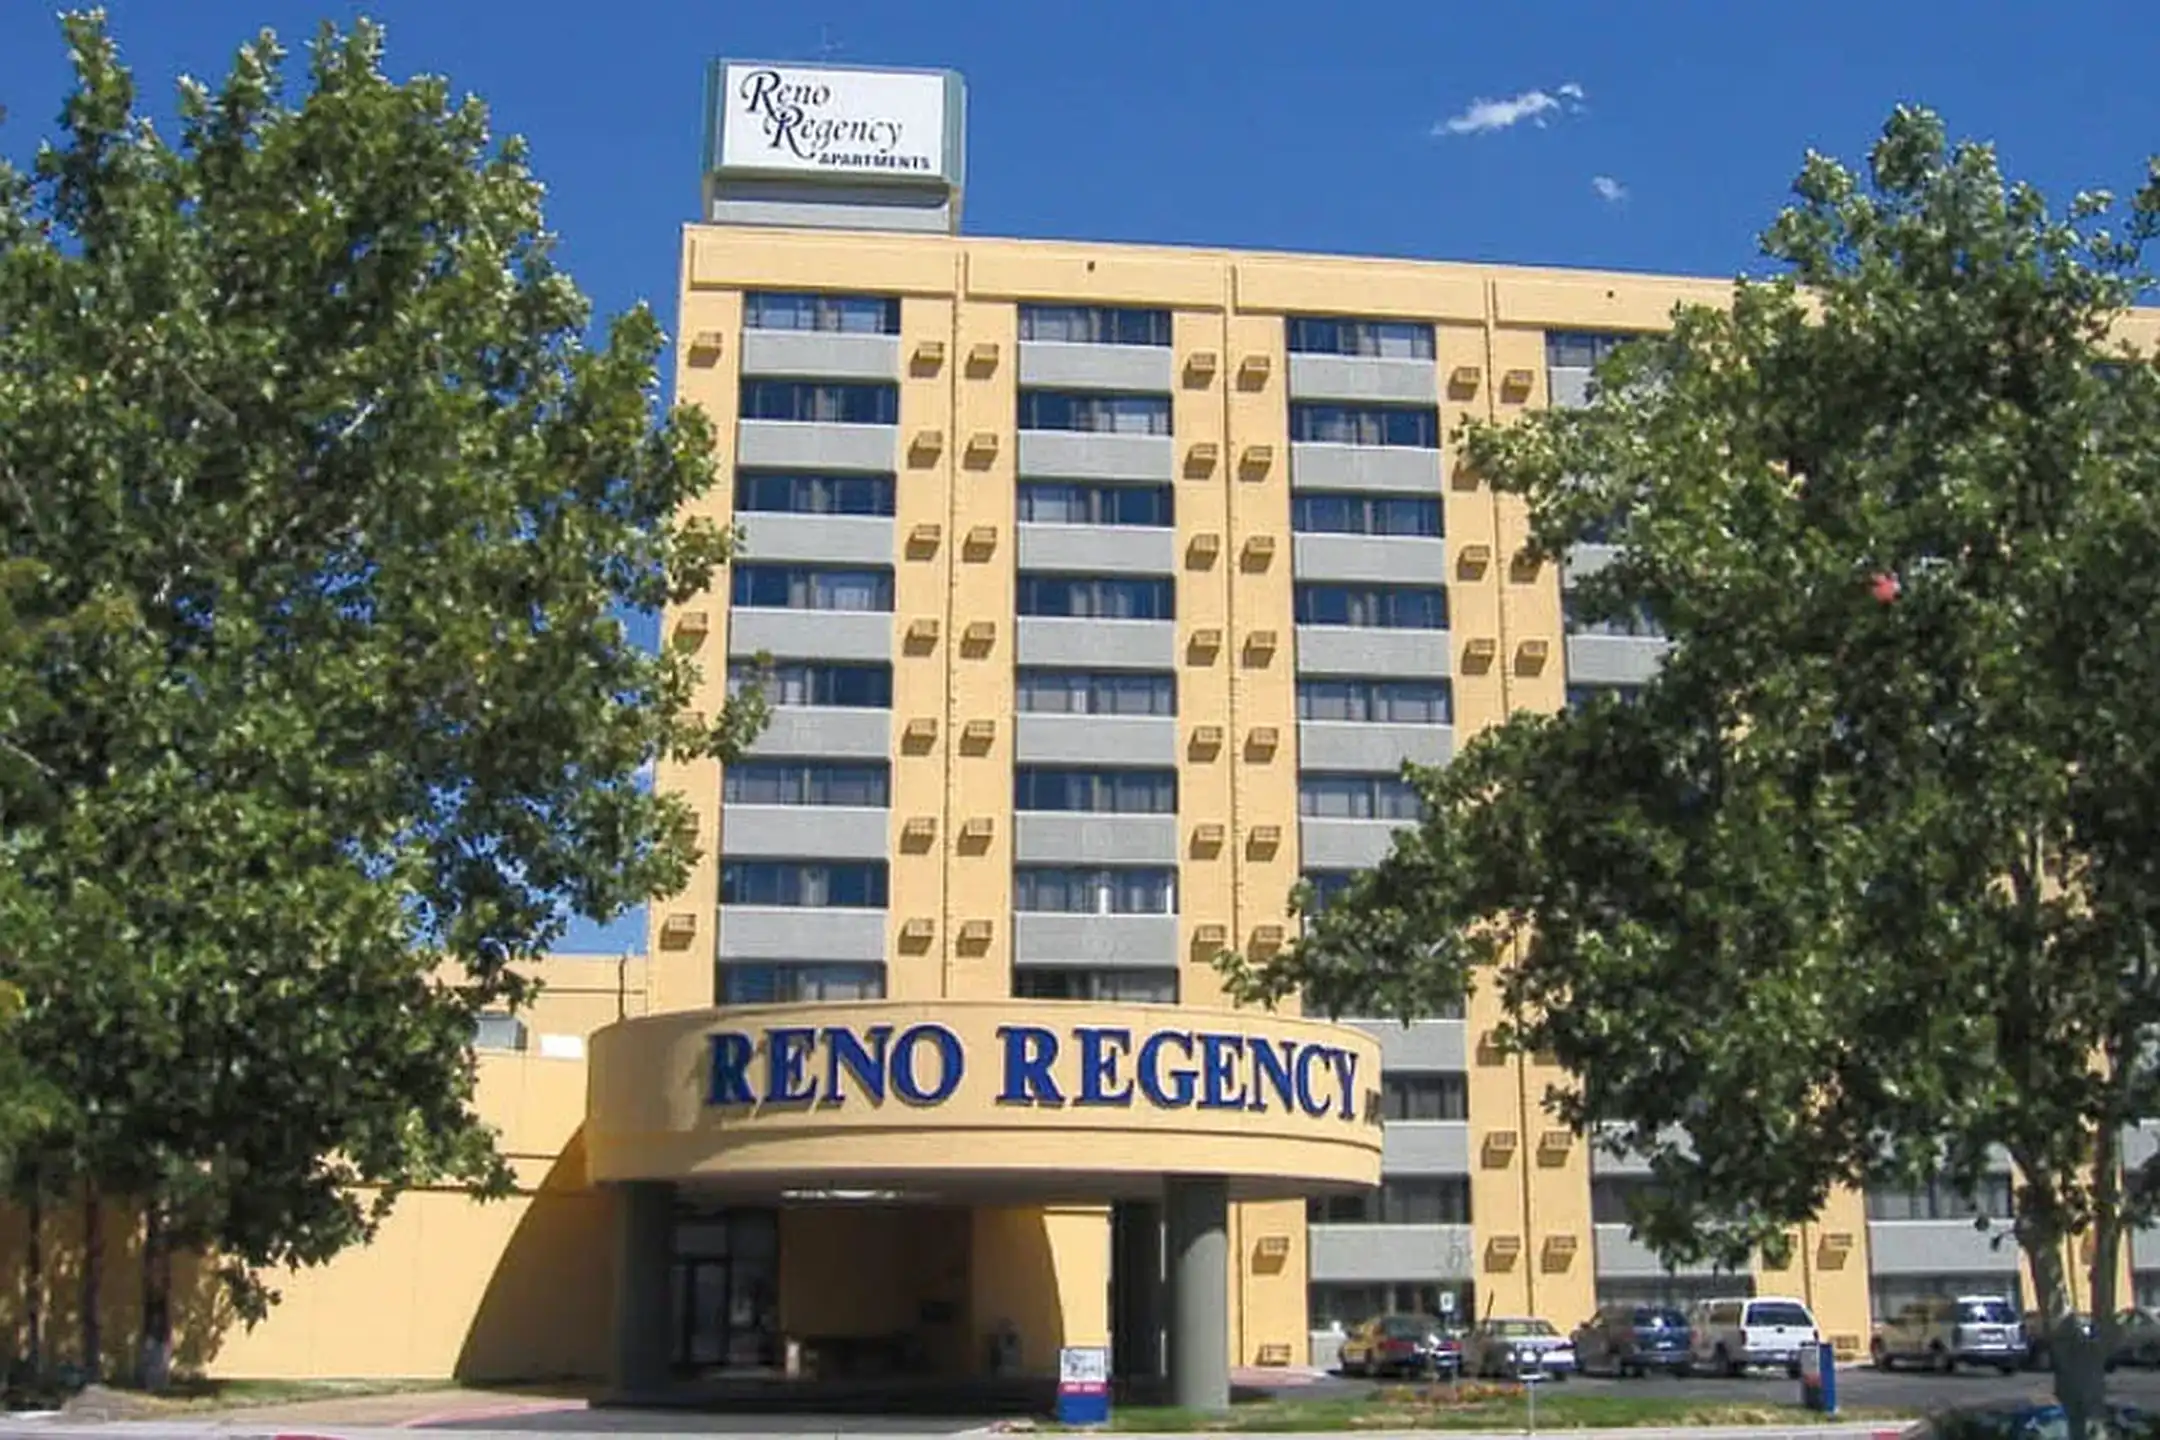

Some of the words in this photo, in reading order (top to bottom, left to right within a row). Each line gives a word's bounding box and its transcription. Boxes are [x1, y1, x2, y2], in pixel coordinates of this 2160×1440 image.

[740, 70, 831, 122] Reno
[764, 105, 902, 159] Regency
[818, 151, 931, 170] APARTMENTS
[705, 1024, 965, 1107] RENO
[996, 1026, 1359, 1120] REGENCY
